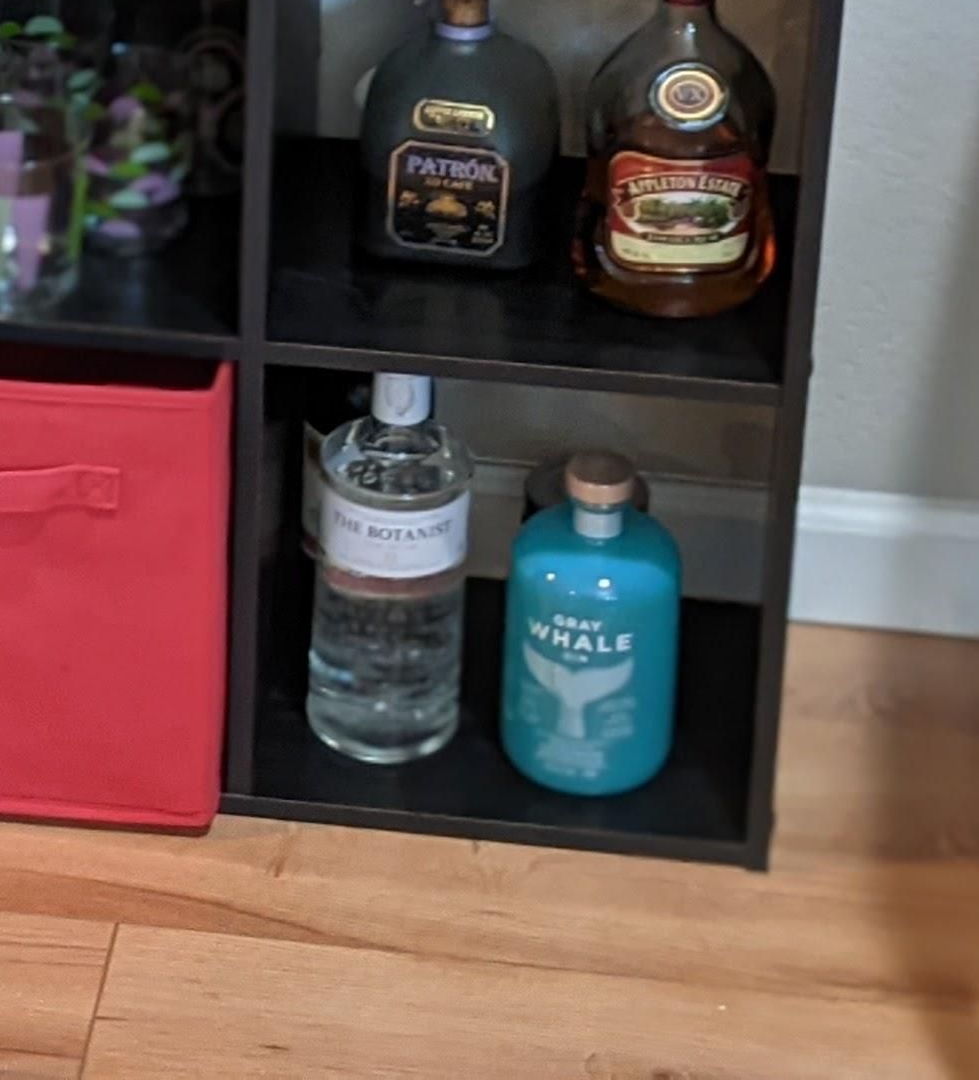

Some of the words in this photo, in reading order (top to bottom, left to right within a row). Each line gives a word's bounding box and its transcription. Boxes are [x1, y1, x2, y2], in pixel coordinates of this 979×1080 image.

[406, 154, 499, 183] PATRÓN
[628, 176, 696, 197] APPLETON
[701, 173, 742, 197] ESTATE
[333, 510, 364, 534] THE
[367, 519, 452, 542] BOTANIST
[528, 618, 634, 653] WHALE
[553, 613, 602, 632] GRAY
